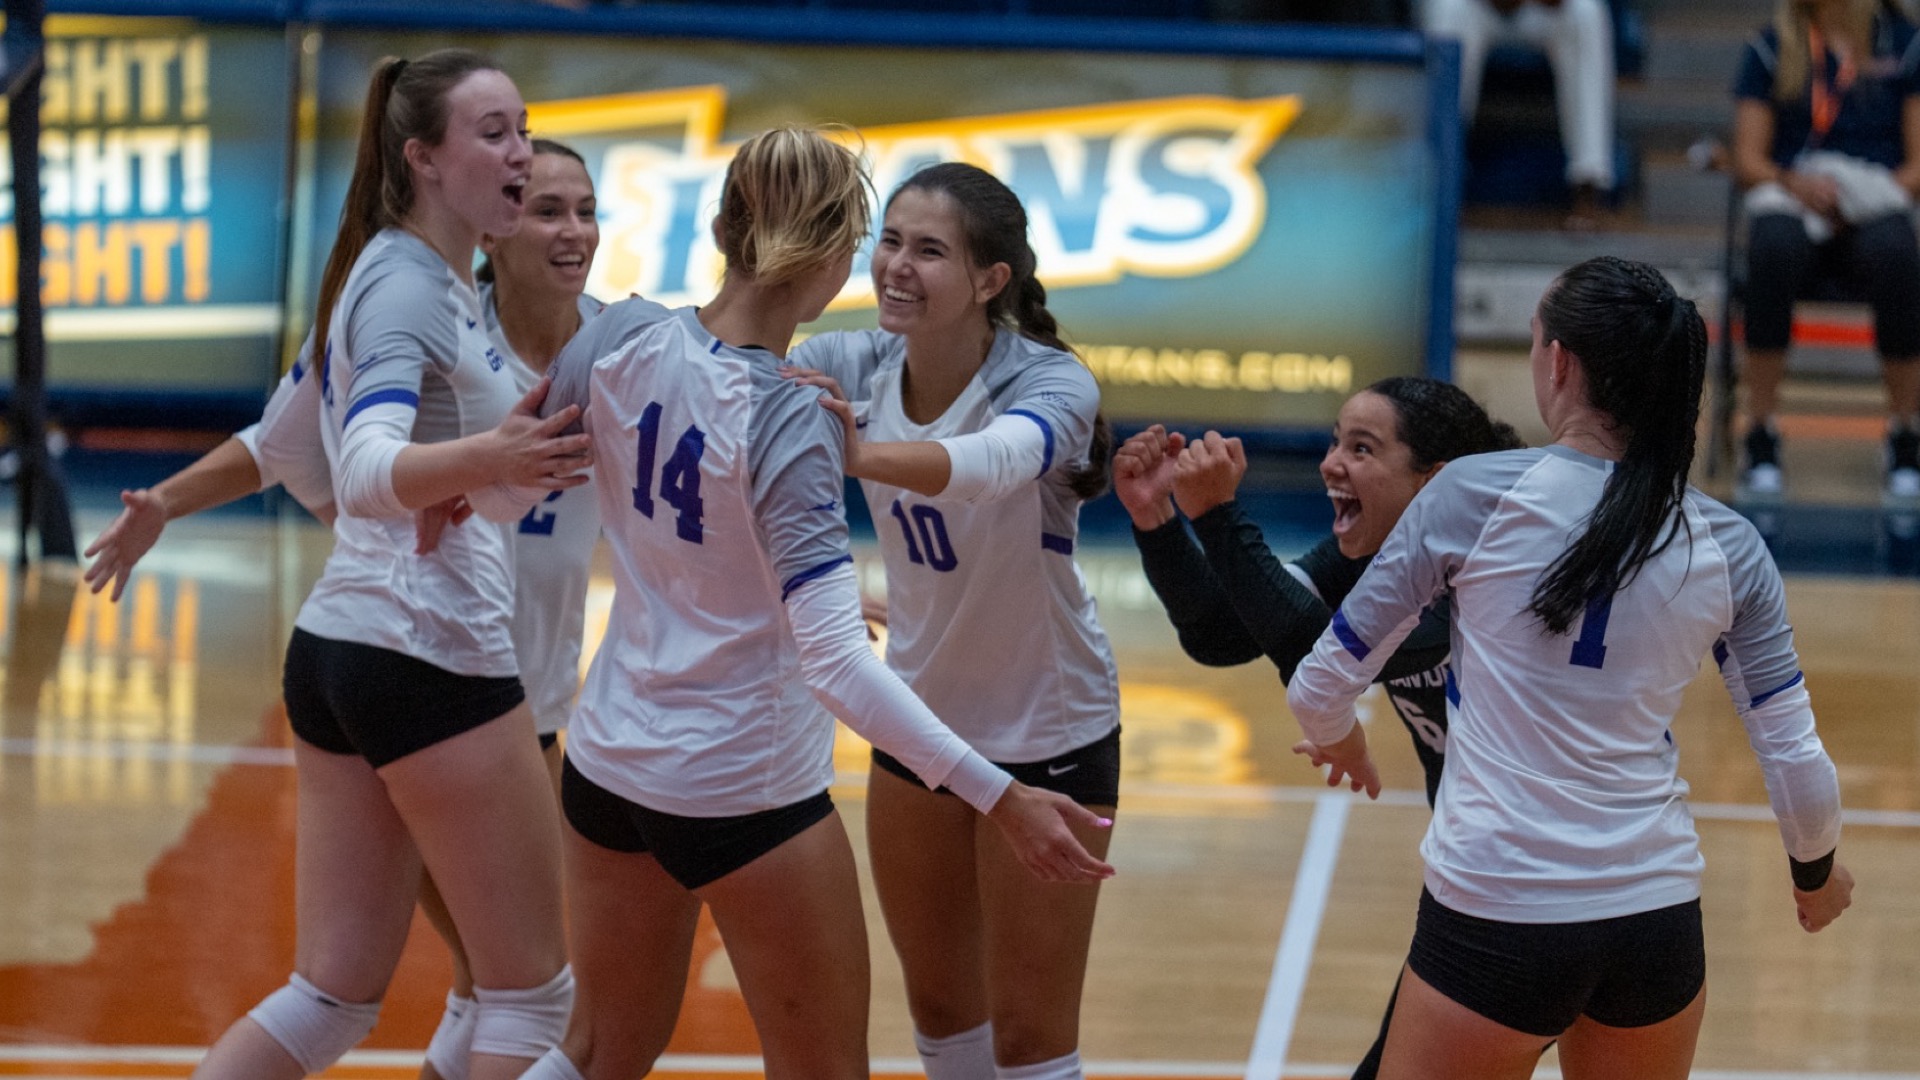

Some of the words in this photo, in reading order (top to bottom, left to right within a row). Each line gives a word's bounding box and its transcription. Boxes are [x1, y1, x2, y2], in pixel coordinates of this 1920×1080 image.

[633, 401, 706, 544] 14
[891, 499, 958, 573] 10
[1569, 585, 1614, 669] 1
[1392, 694, 1447, 755] 6
